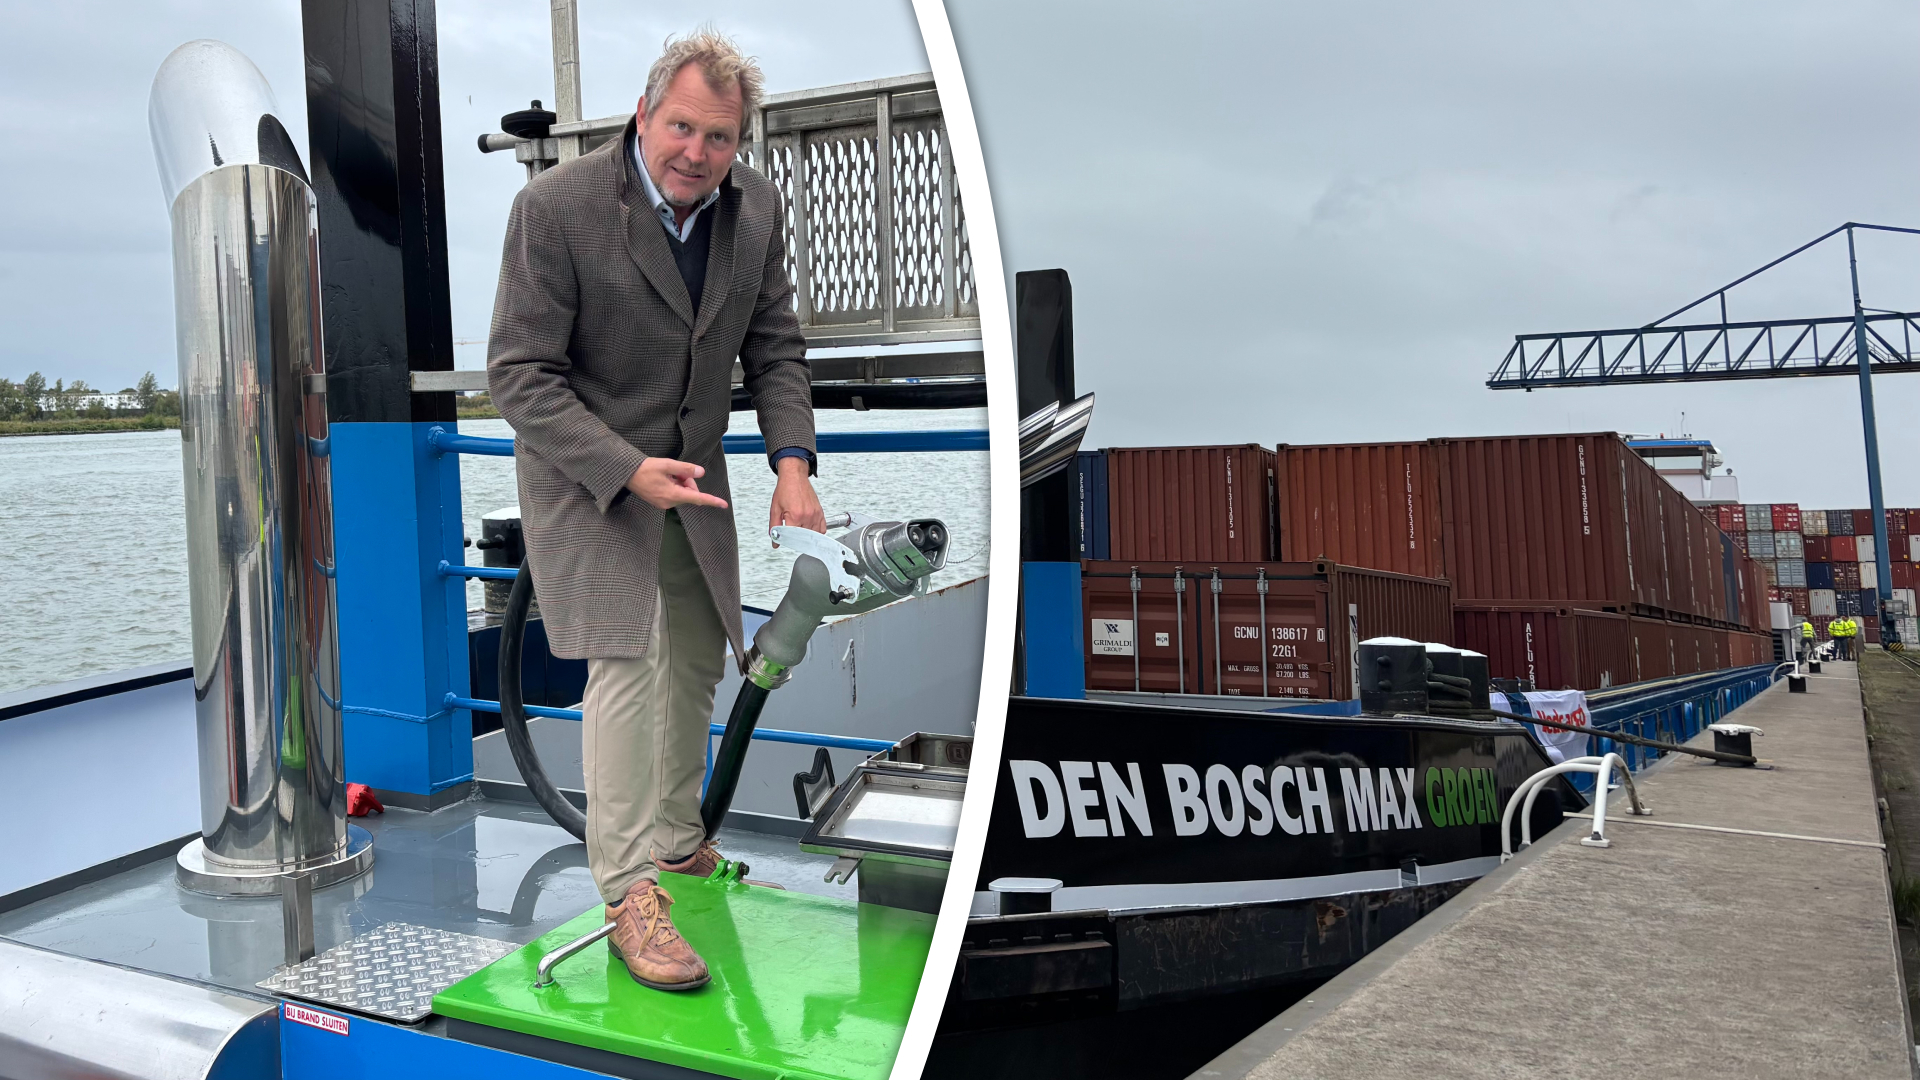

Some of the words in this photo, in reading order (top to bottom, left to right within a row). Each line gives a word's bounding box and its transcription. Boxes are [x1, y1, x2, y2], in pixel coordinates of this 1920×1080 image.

[1578, 444, 1586, 476] GCNU
[1093, 639, 1132, 647] GRIMALDI
[1234, 626, 1259, 639] GCNU
[1271, 627, 1308, 640] 138617
[1317, 628, 1325, 642] 0
[1525, 622, 1534, 662] ACLU
[1272, 644, 1297, 657] 22G1
[1009, 759, 1153, 839] DEN
[1162, 763, 1335, 837] BOSCH
[1339, 766, 1423, 833] MAX
[1425, 766, 1499, 828] GROEN
[297, 1009, 320, 1024] BRAND
[322, 1015, 348, 1033] SLUITEN
